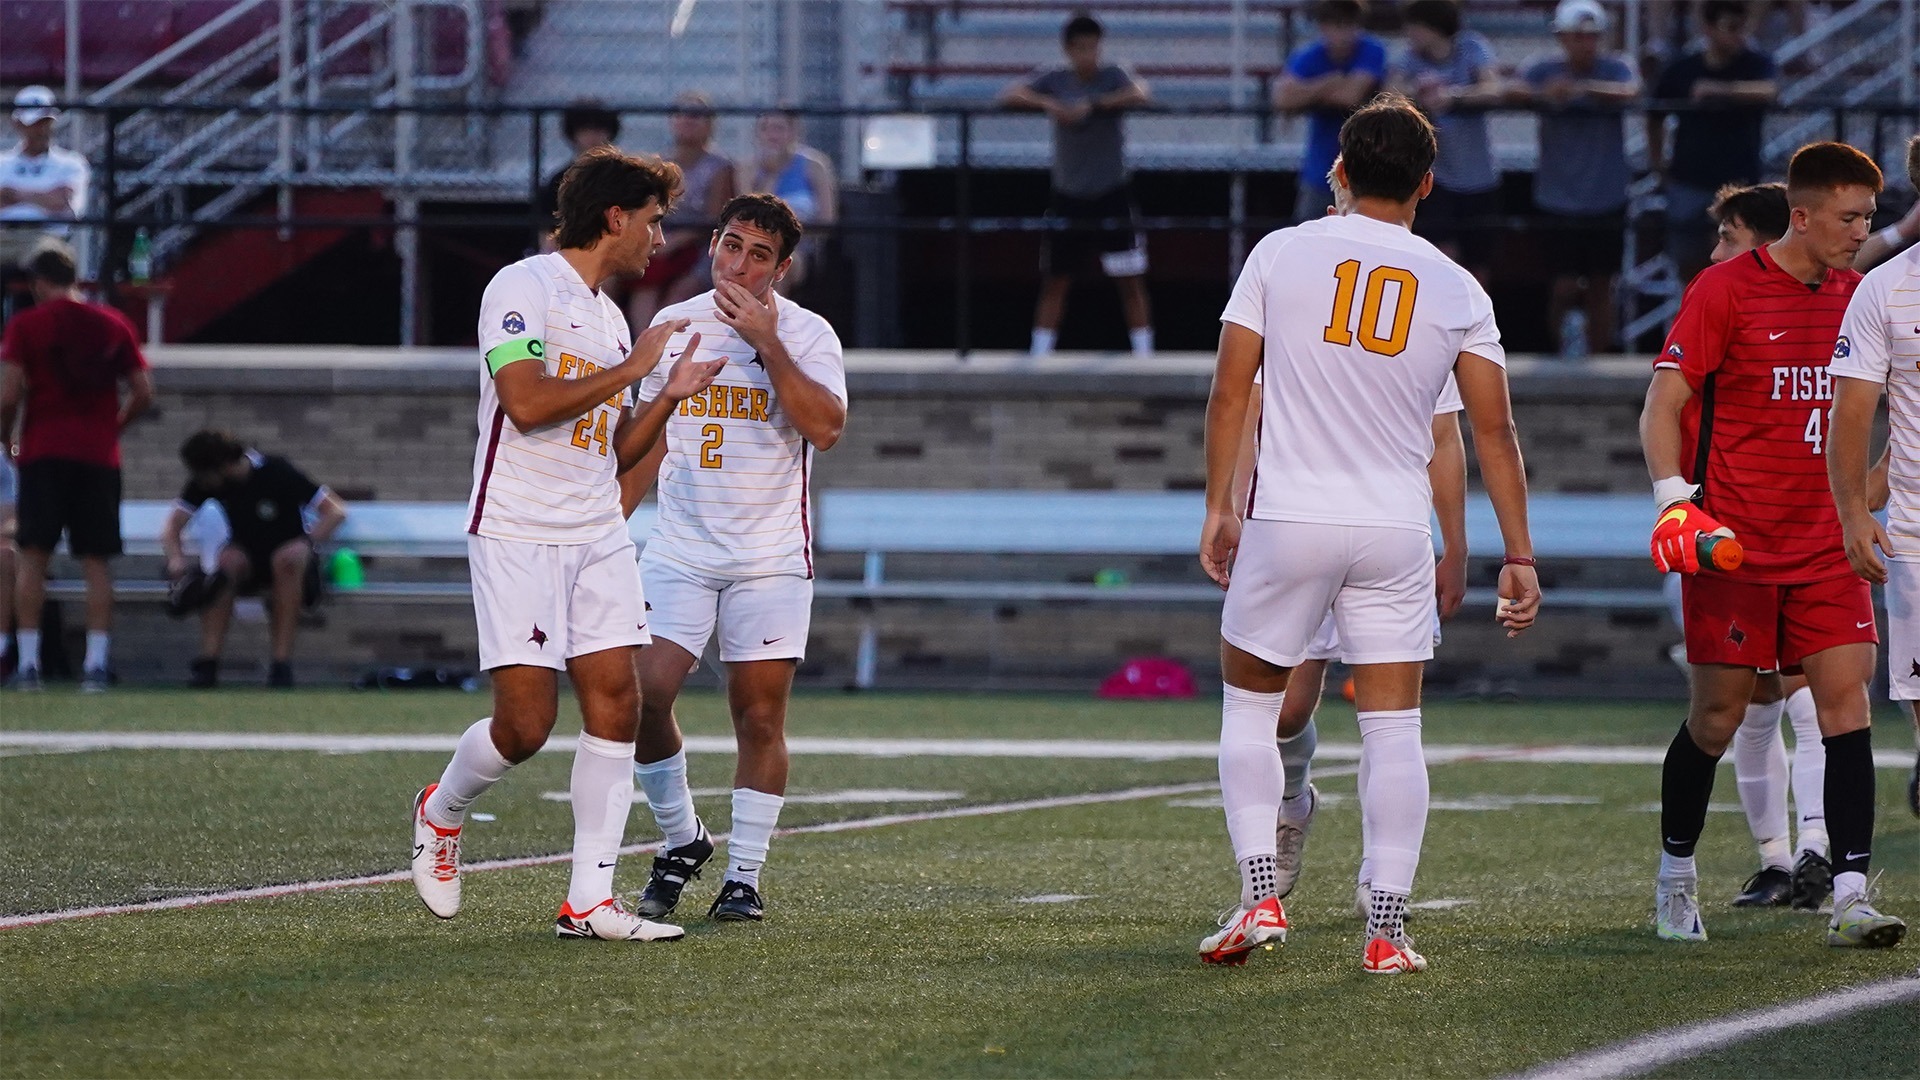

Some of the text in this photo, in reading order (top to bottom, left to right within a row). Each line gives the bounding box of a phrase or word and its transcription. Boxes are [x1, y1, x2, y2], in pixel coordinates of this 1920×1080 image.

[1323, 259, 1419, 357] 10
[526, 339, 543, 357] C
[671, 384, 769, 422] ISHER
[1771, 365, 1833, 401] FISH
[571, 407, 608, 457] 24
[700, 423, 724, 469] 2
[1803, 407, 1833, 455] 4
